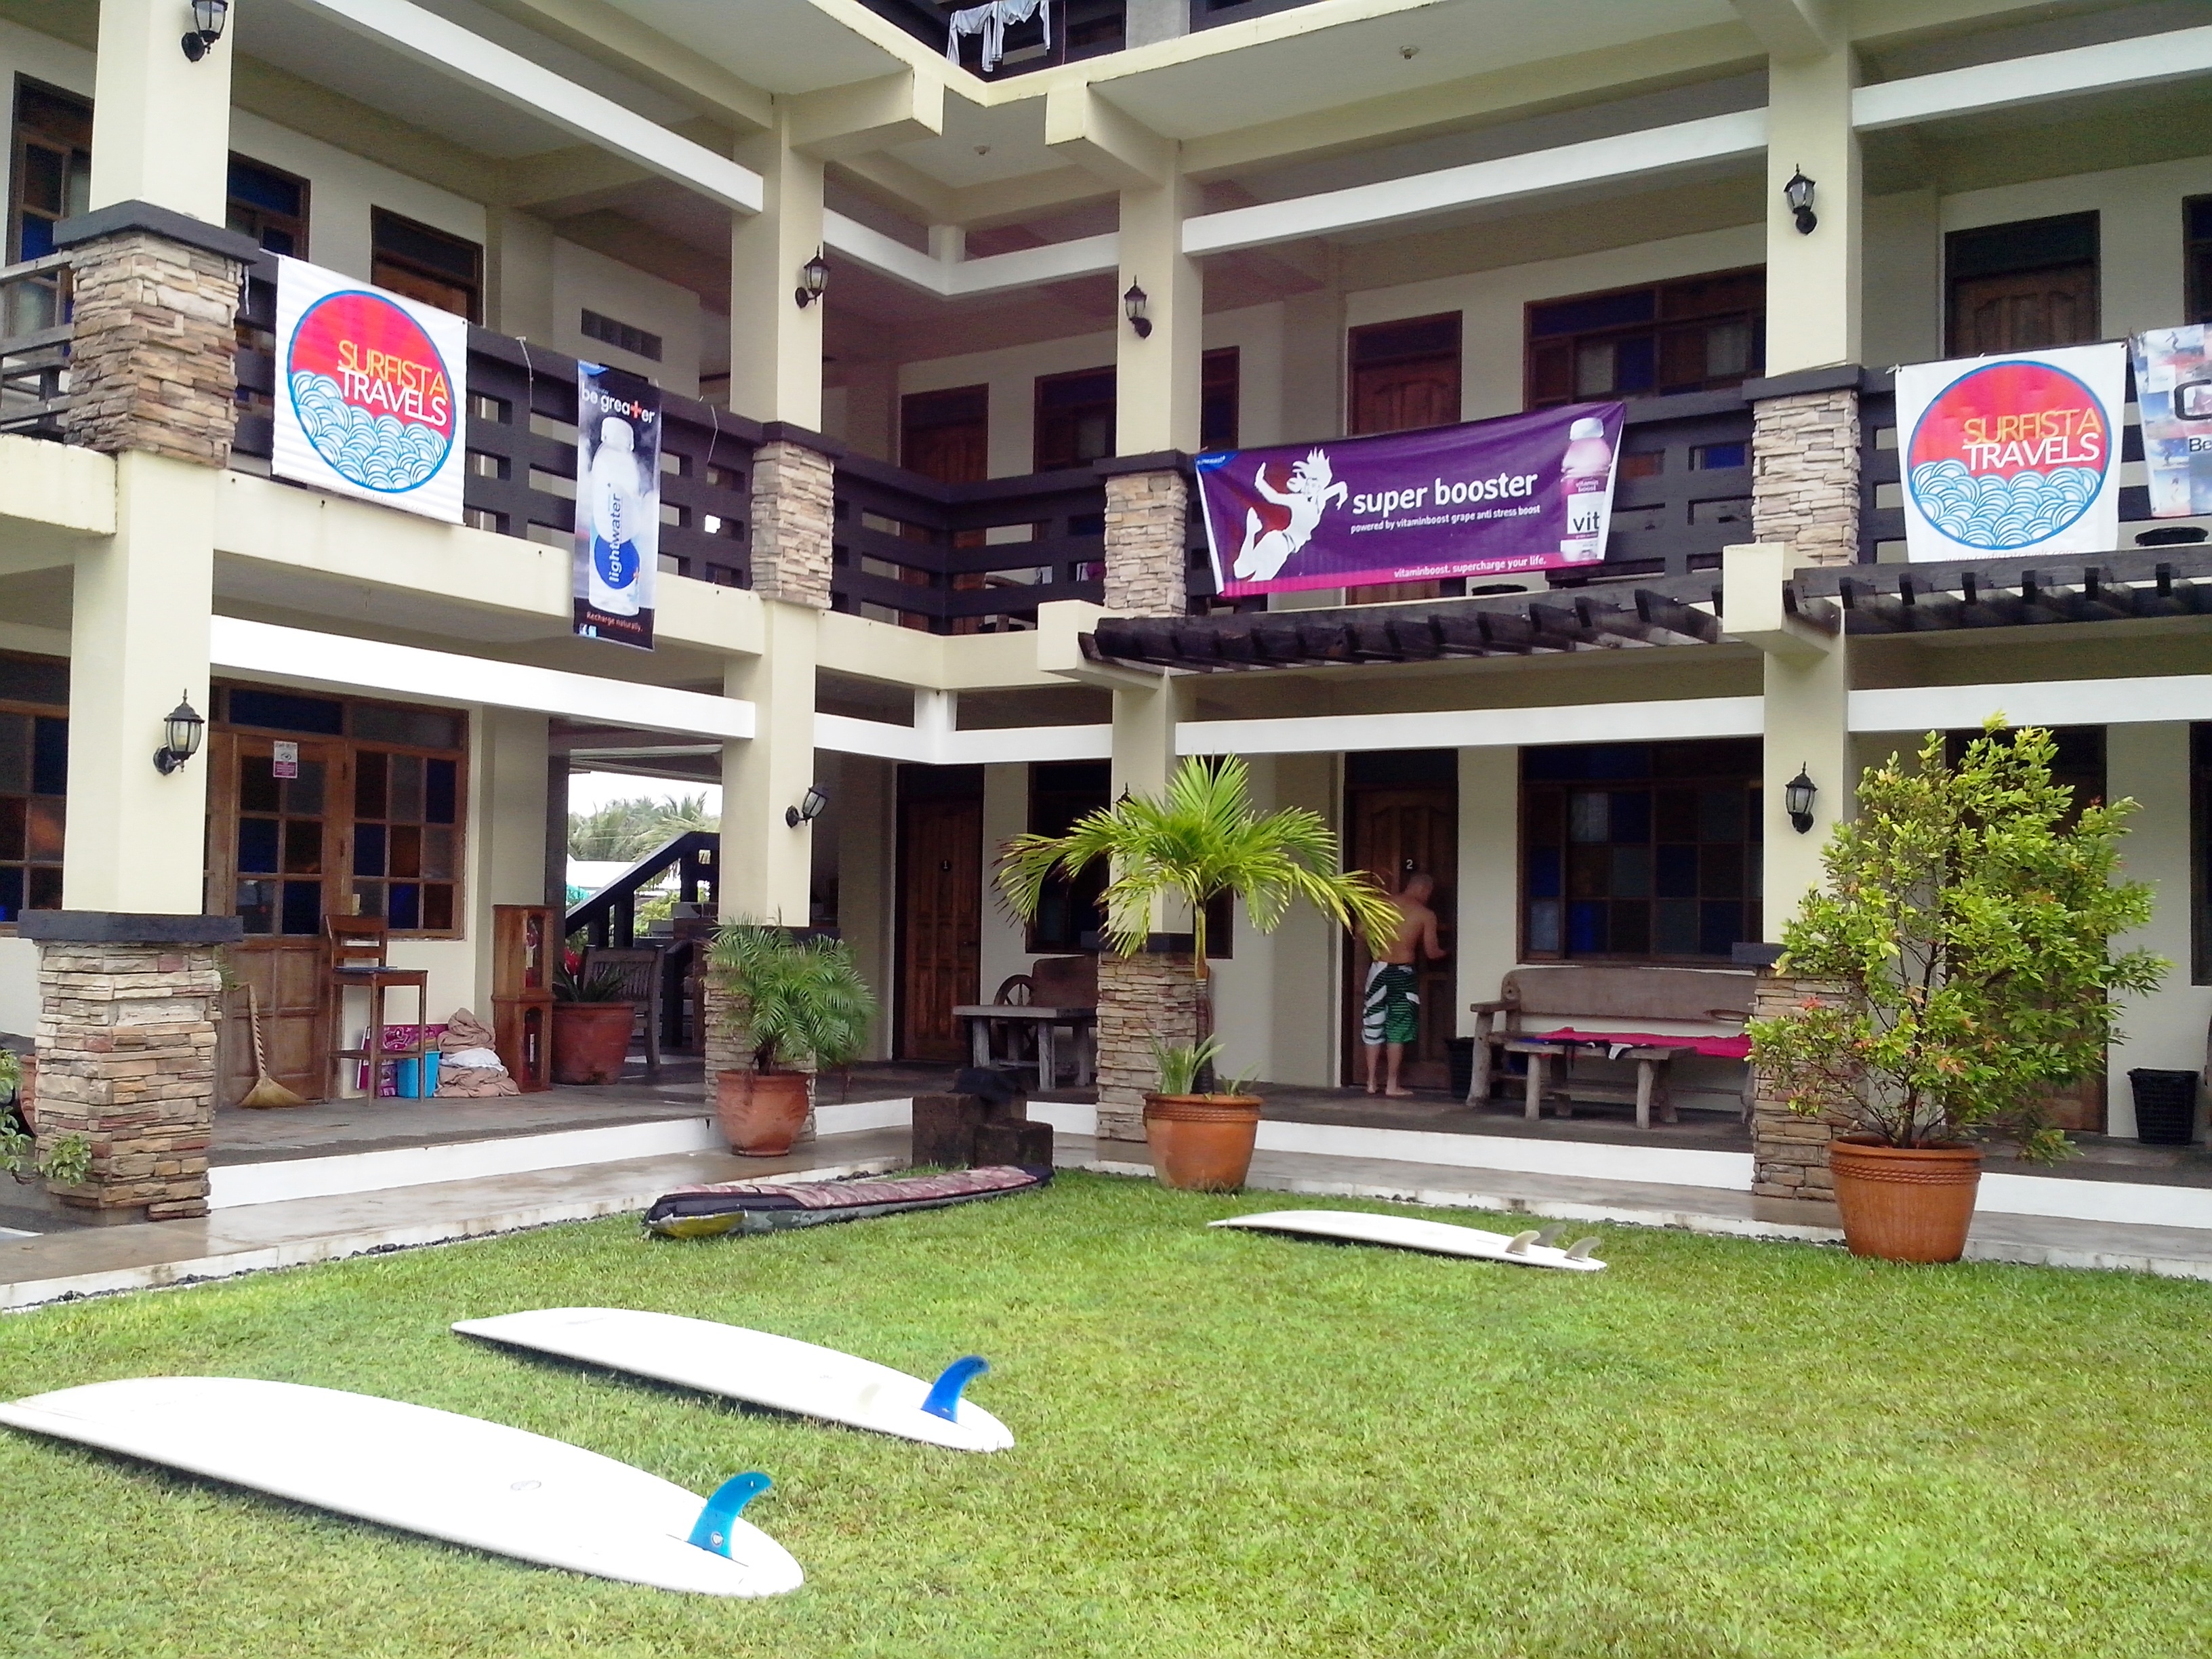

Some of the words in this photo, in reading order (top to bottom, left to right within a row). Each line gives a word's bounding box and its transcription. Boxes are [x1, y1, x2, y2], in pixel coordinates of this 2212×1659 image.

[338, 340, 449, 401] SURFISTA
[337, 366, 447, 426] TRAVELS
[581, 380, 598, 404] be
[1963, 407, 2102, 445] SURFISTA
[1962, 432, 2100, 470] TRAVELS
[1352, 487, 1428, 518] super
[1435, 472, 1538, 506] booster
[1351, 520, 1384, 534] powered
[1385, 518, 1395, 531] by
[1396, 514, 1450, 528] vitaminboost
[1451, 512, 1475, 525] grape
[1477, 509, 1492, 520] anti
[1493, 506, 1517, 518] stress
[1518, 504, 1540, 516] boost
[1573, 511, 1600, 531] vit
[609, 493, 623, 583] lightwater
[1394, 565, 1450, 578] vitaminboost.
[1452, 560, 1505, 574] supercharge
[1507, 558, 1528, 570] your
[1530, 555, 1547, 566] life.
[586, 611, 615, 626] Recharge
[943, 860, 948, 869] 1
[1406, 859, 1413, 869] 2
